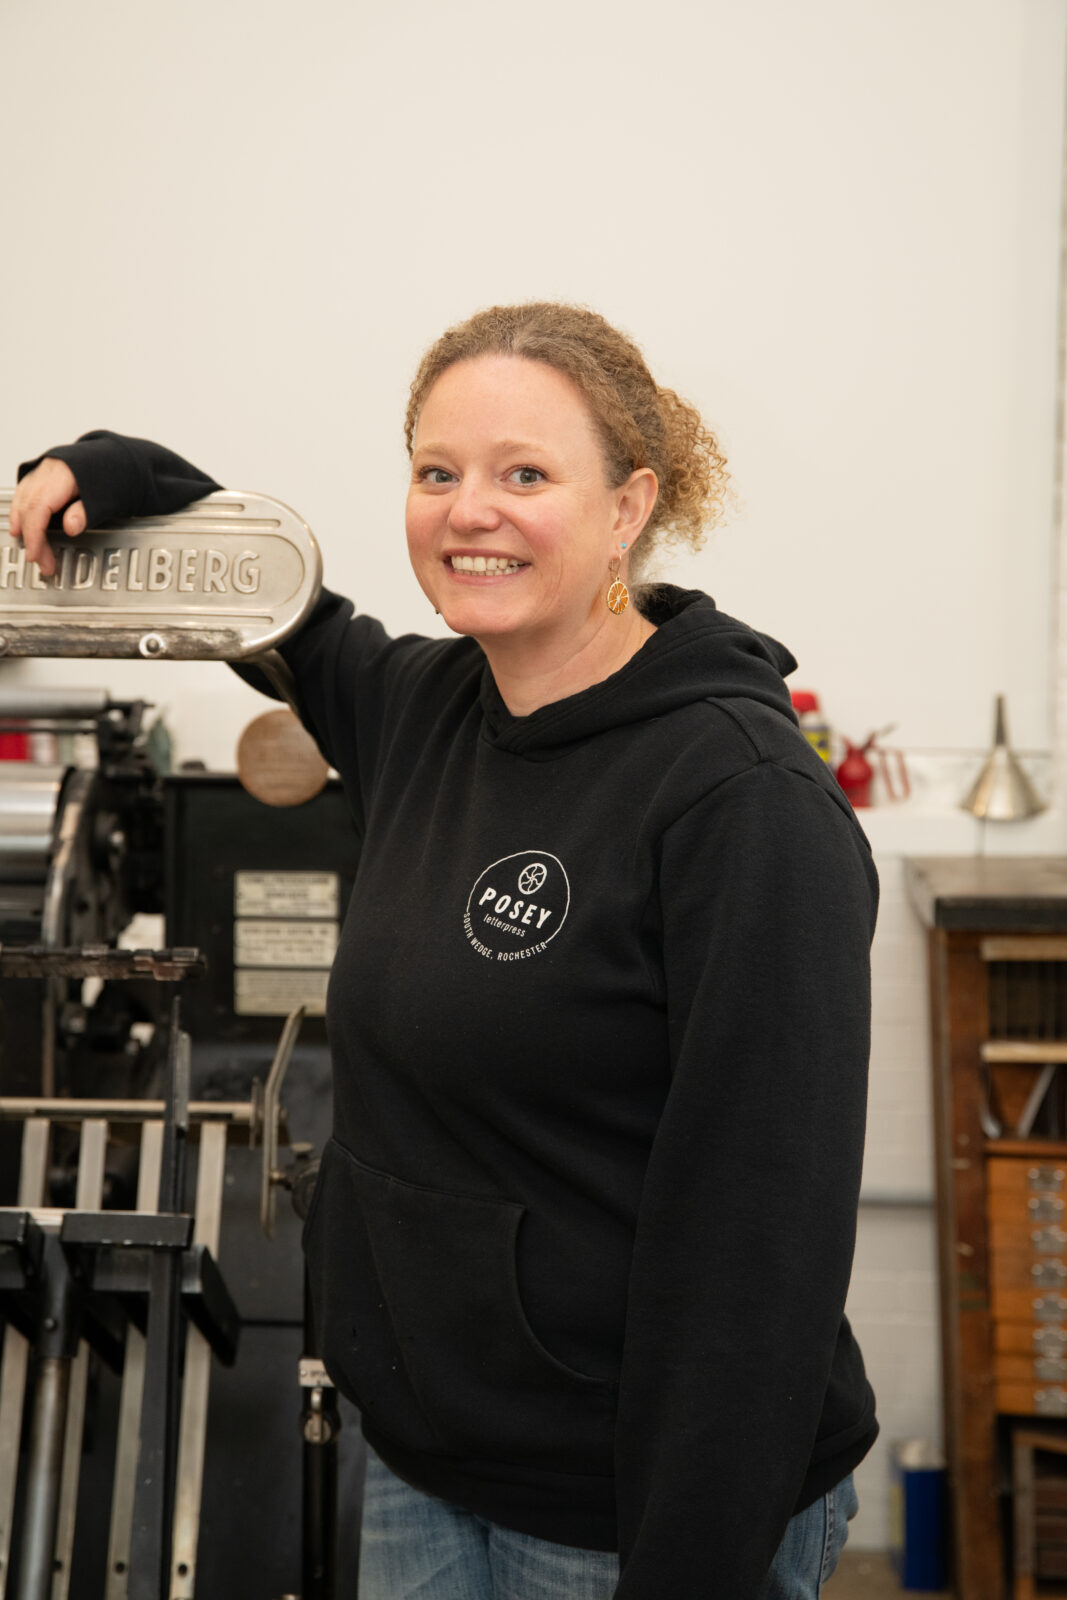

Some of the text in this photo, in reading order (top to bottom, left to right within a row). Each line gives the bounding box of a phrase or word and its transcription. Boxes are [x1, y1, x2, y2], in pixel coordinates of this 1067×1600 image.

[478, 886, 553, 929] POSEY
[483, 913, 526, 938] letterpress
[463, 912, 475, 939] SOUTH
[497, 941, 548, 962] ROCHESTER
